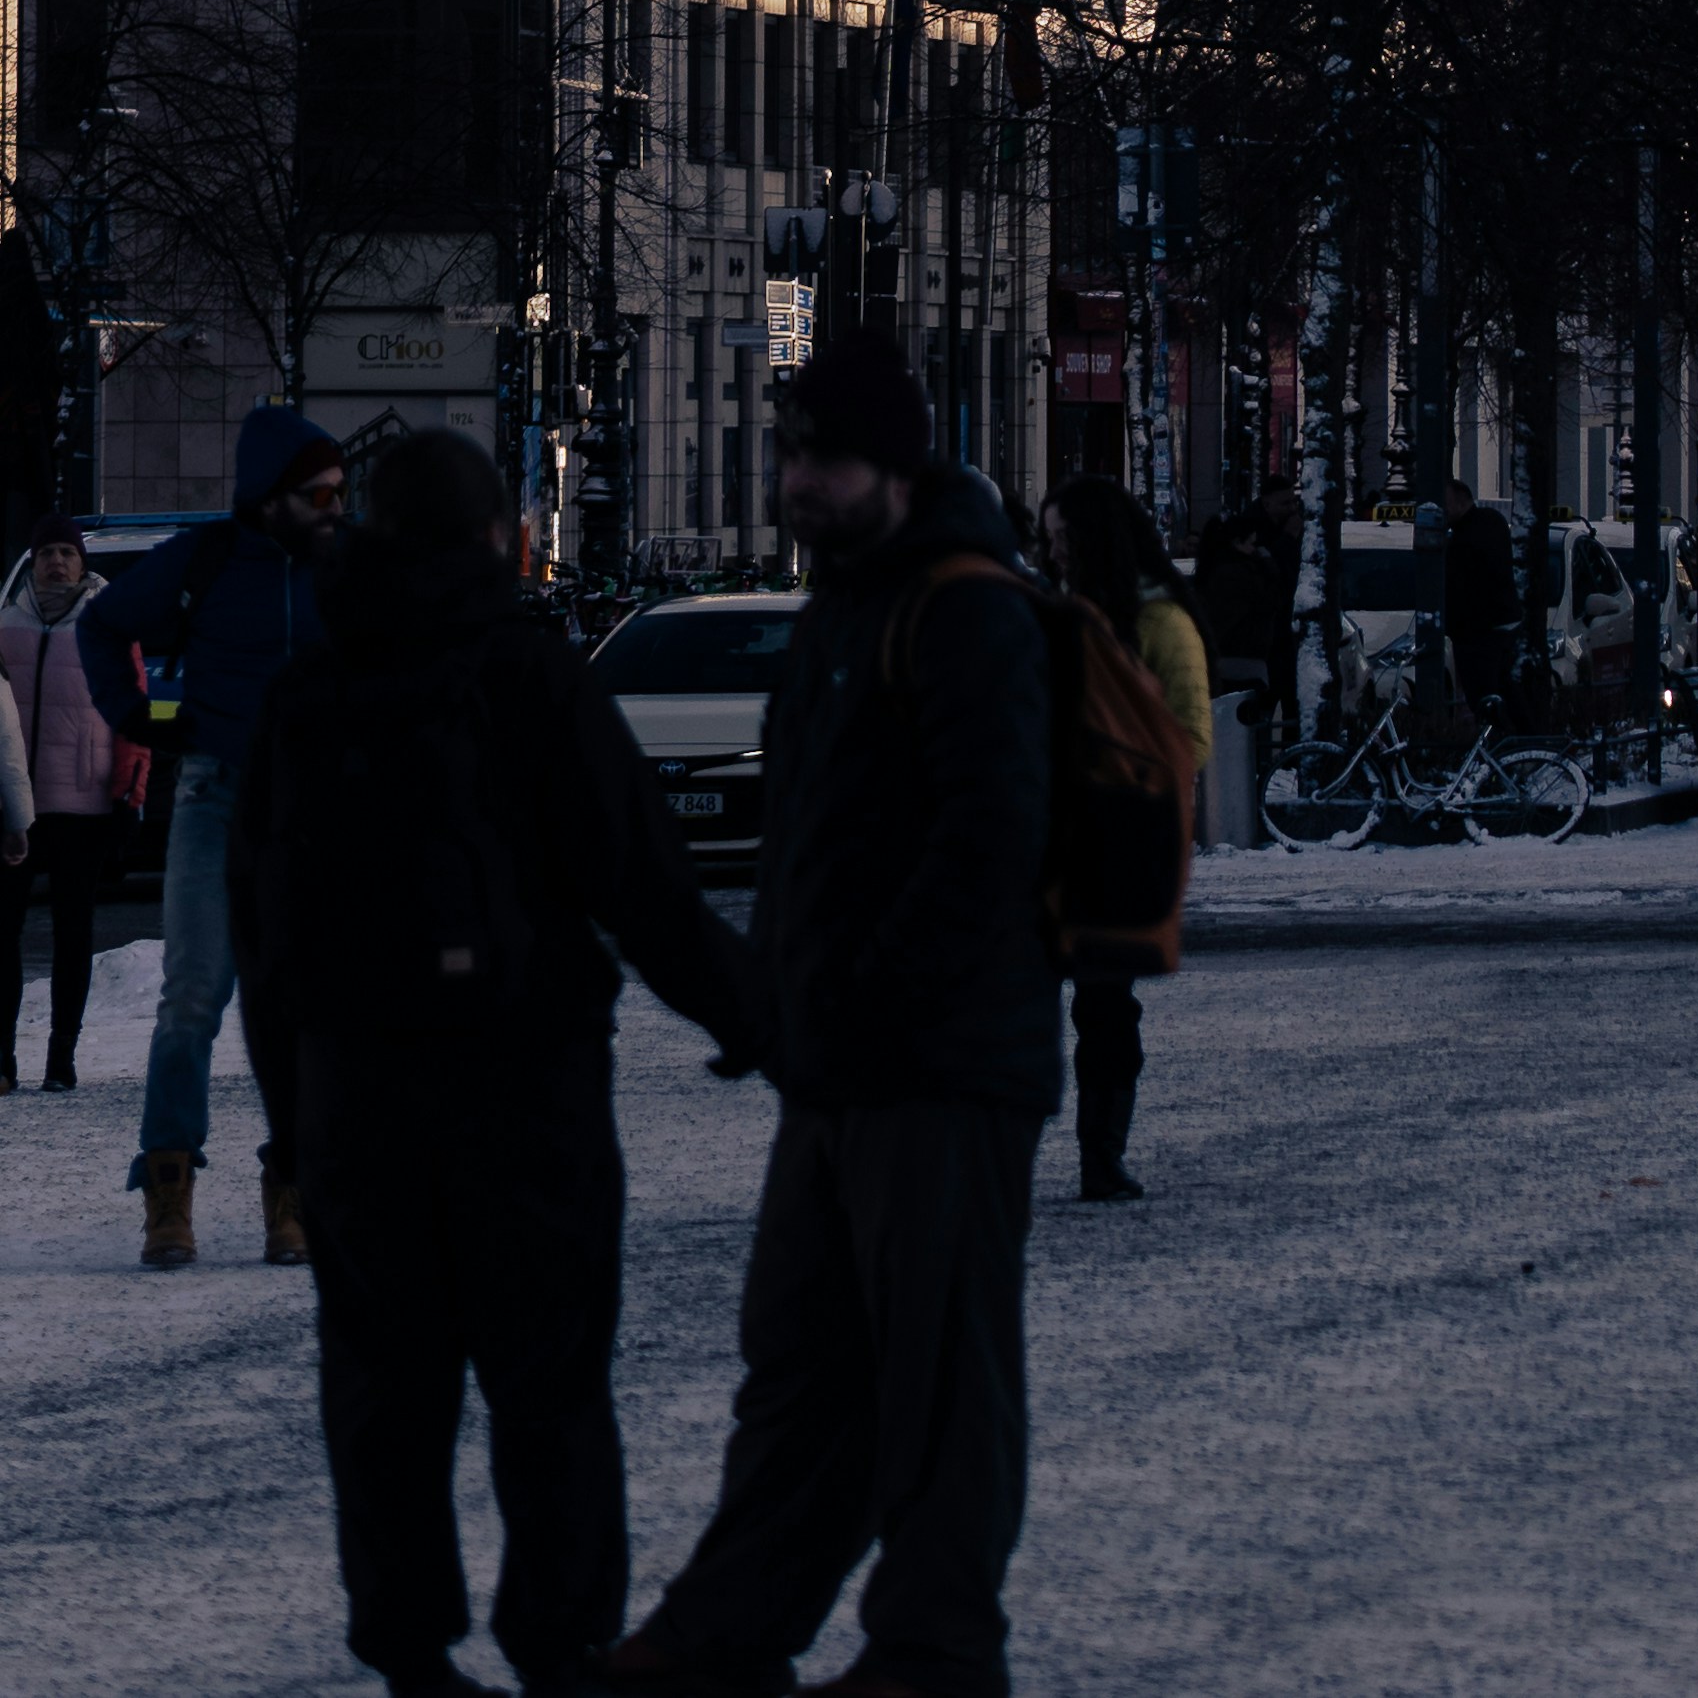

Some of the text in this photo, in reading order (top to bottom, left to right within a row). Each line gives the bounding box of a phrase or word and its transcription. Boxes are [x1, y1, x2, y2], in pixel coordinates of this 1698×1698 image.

[1066, 352, 1095, 373] SOUVENR
[450, 412, 474, 425] 1924
[1382, 506, 1415, 518] TAXI
[665, 795, 716, 812] Z 848
